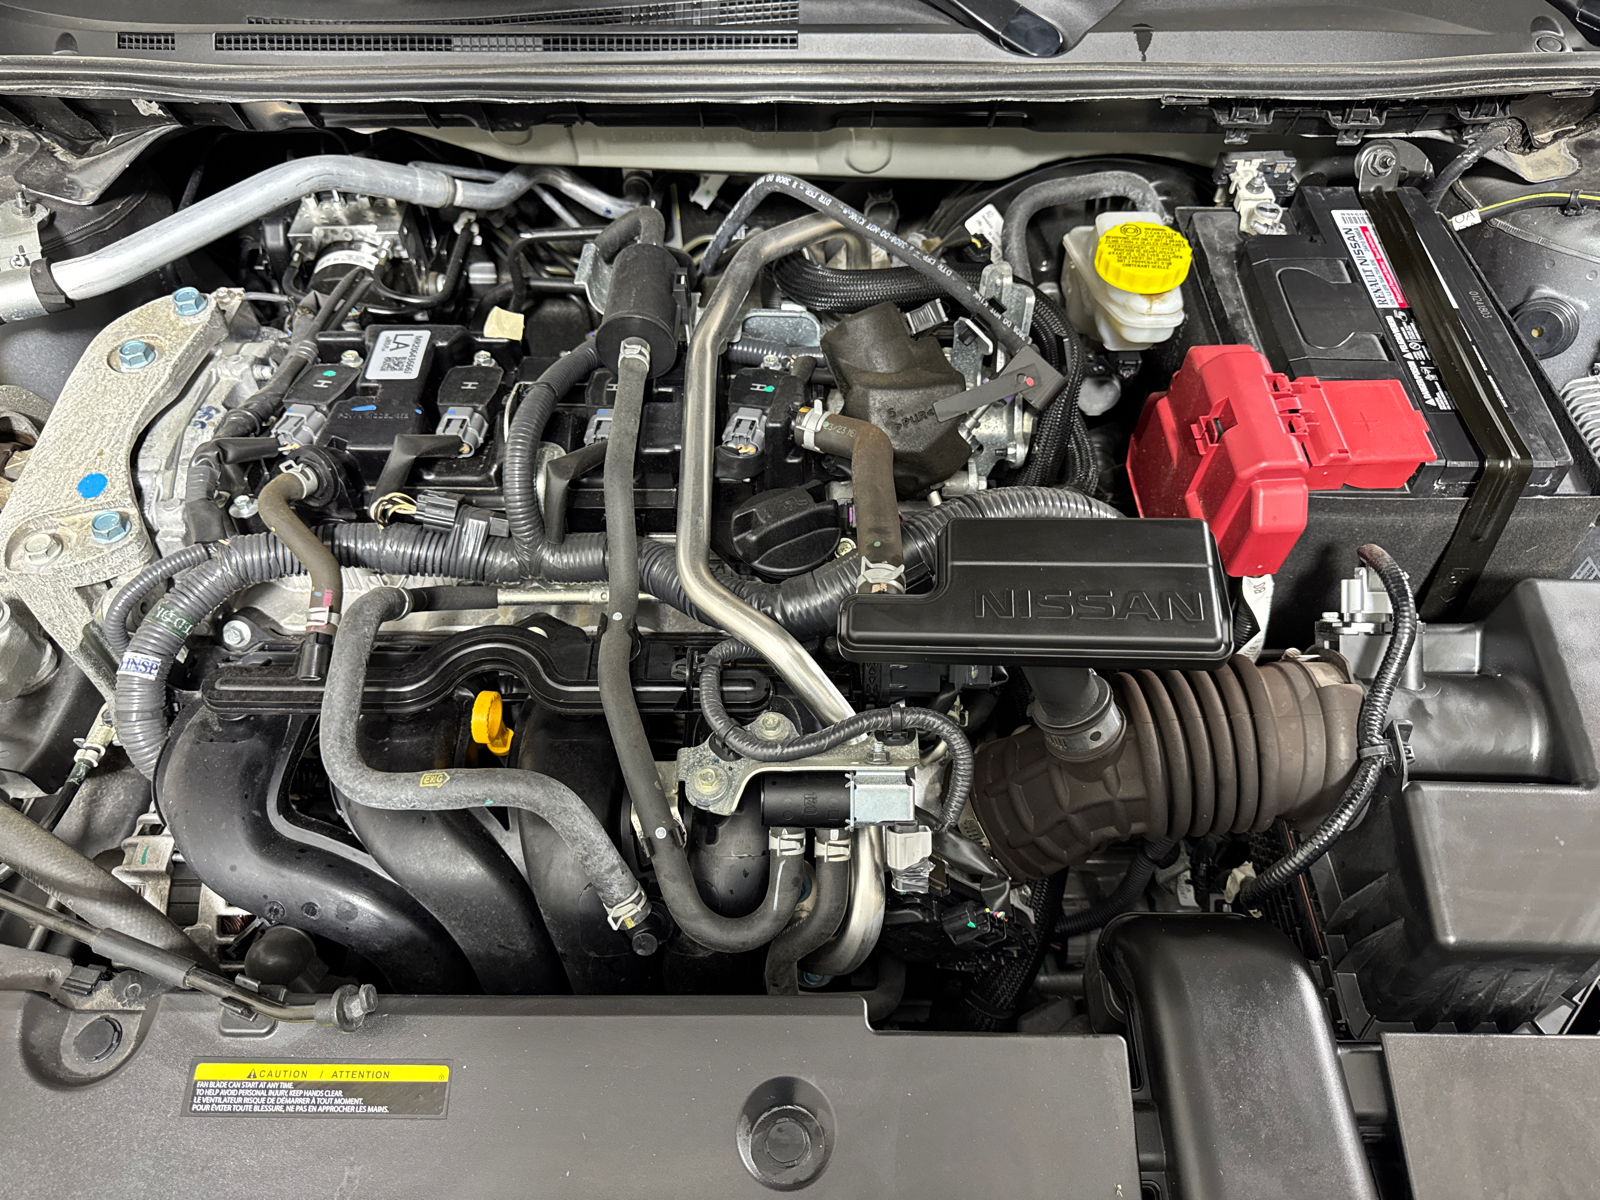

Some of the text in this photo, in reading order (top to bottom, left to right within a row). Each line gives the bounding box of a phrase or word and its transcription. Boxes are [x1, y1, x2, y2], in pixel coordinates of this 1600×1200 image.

[1342, 227, 1370, 266] NISSAN
[1362, 268, 1390, 306] RENAULT
[390, 334, 414, 352] LA
[974, 588, 1205, 621] NISSAN
[804, 792, 818, 816] 120
[259, 1070, 308, 1078] CAUTION
[331, 1070, 390, 1079] ATTENTION
[210, 1104, 232, 1112] ÉVITER
[253, 1105, 285, 1113] BLESSURE,
[276, 1096, 310, 1104] DÉMARRER
